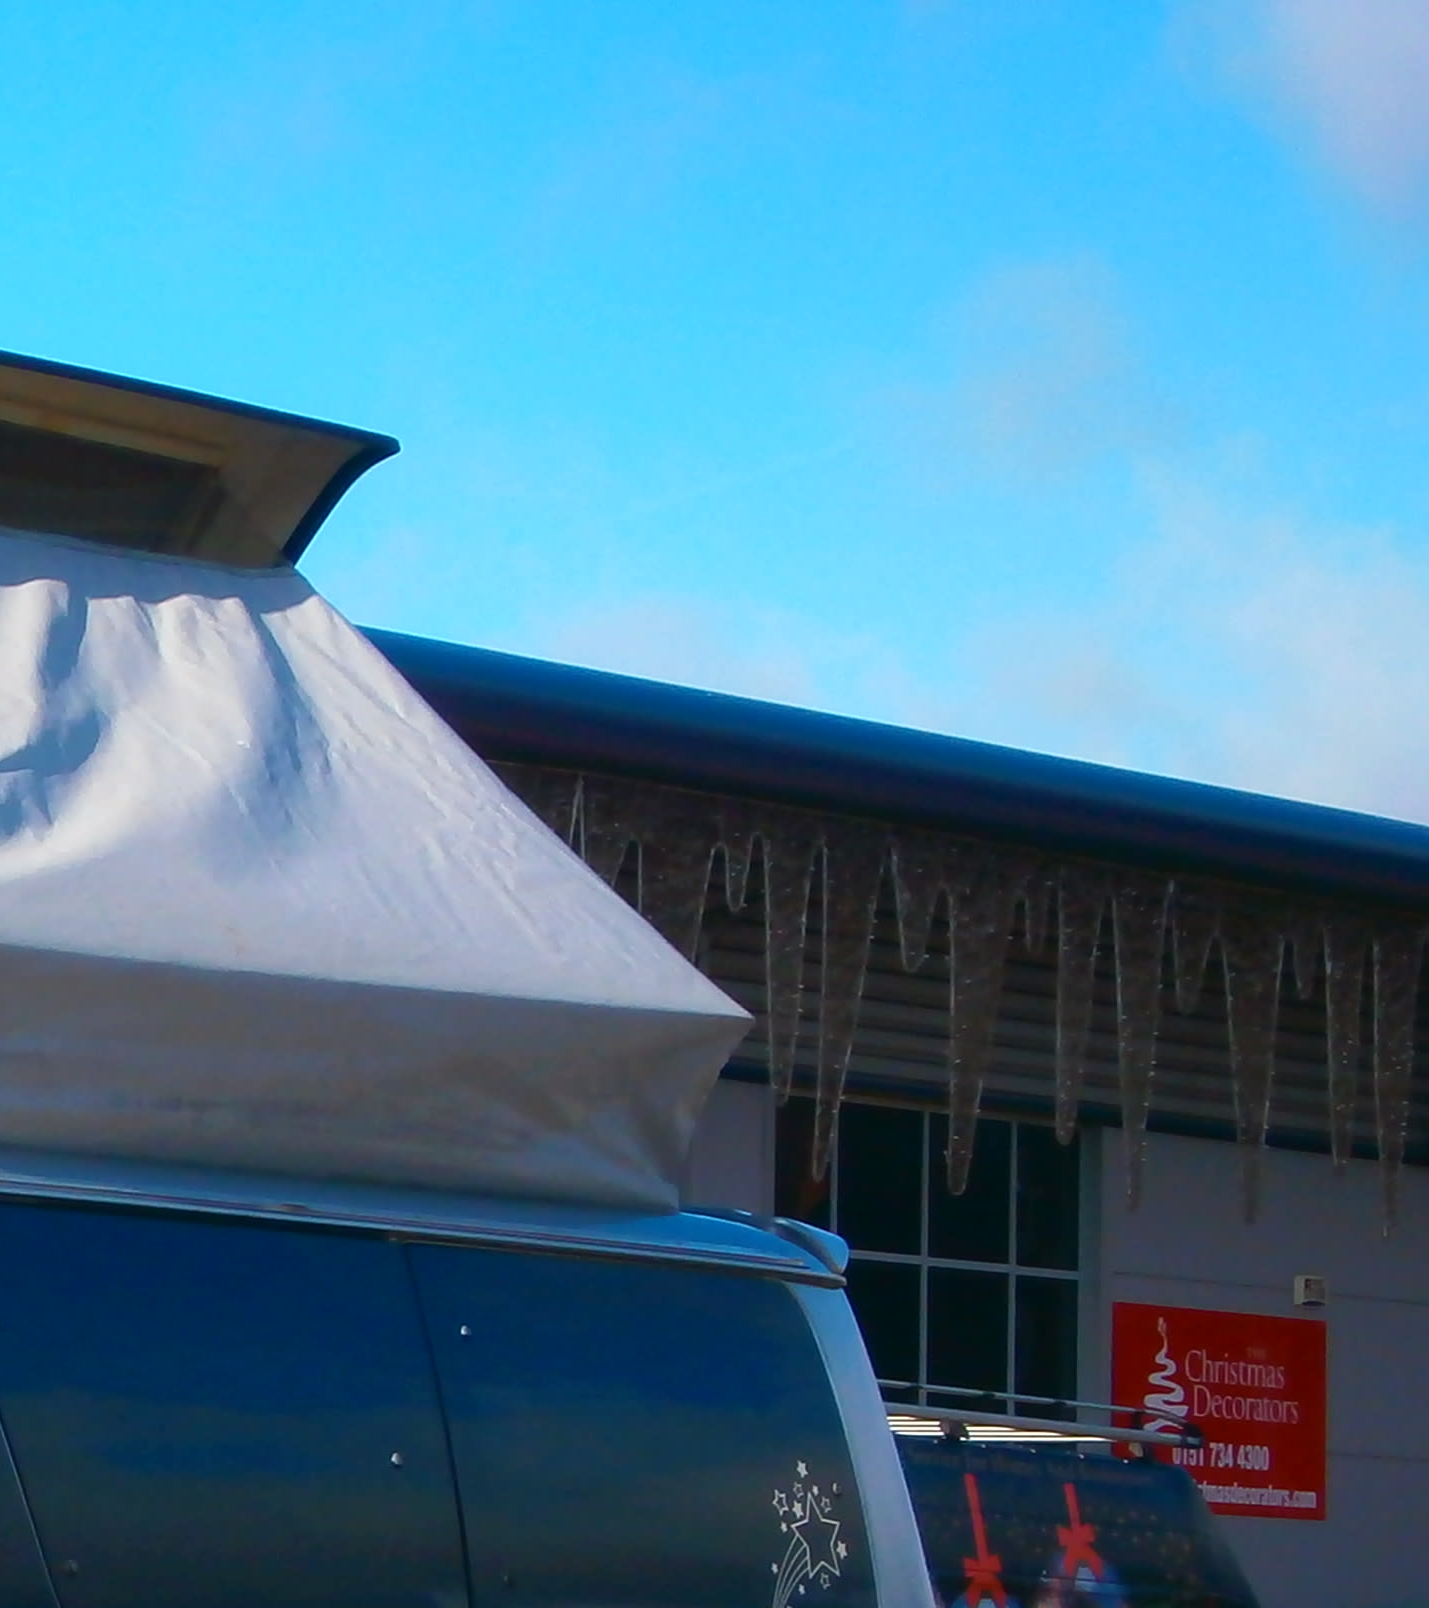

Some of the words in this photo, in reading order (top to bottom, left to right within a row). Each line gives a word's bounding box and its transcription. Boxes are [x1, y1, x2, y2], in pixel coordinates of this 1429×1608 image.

[1185, 1348, 1285, 1389] Christmas
[1193, 1385, 1300, 1424] Decorators
[1209, 1442, 1234, 1468] 734
[1236, 1444, 1270, 1471] 4300
